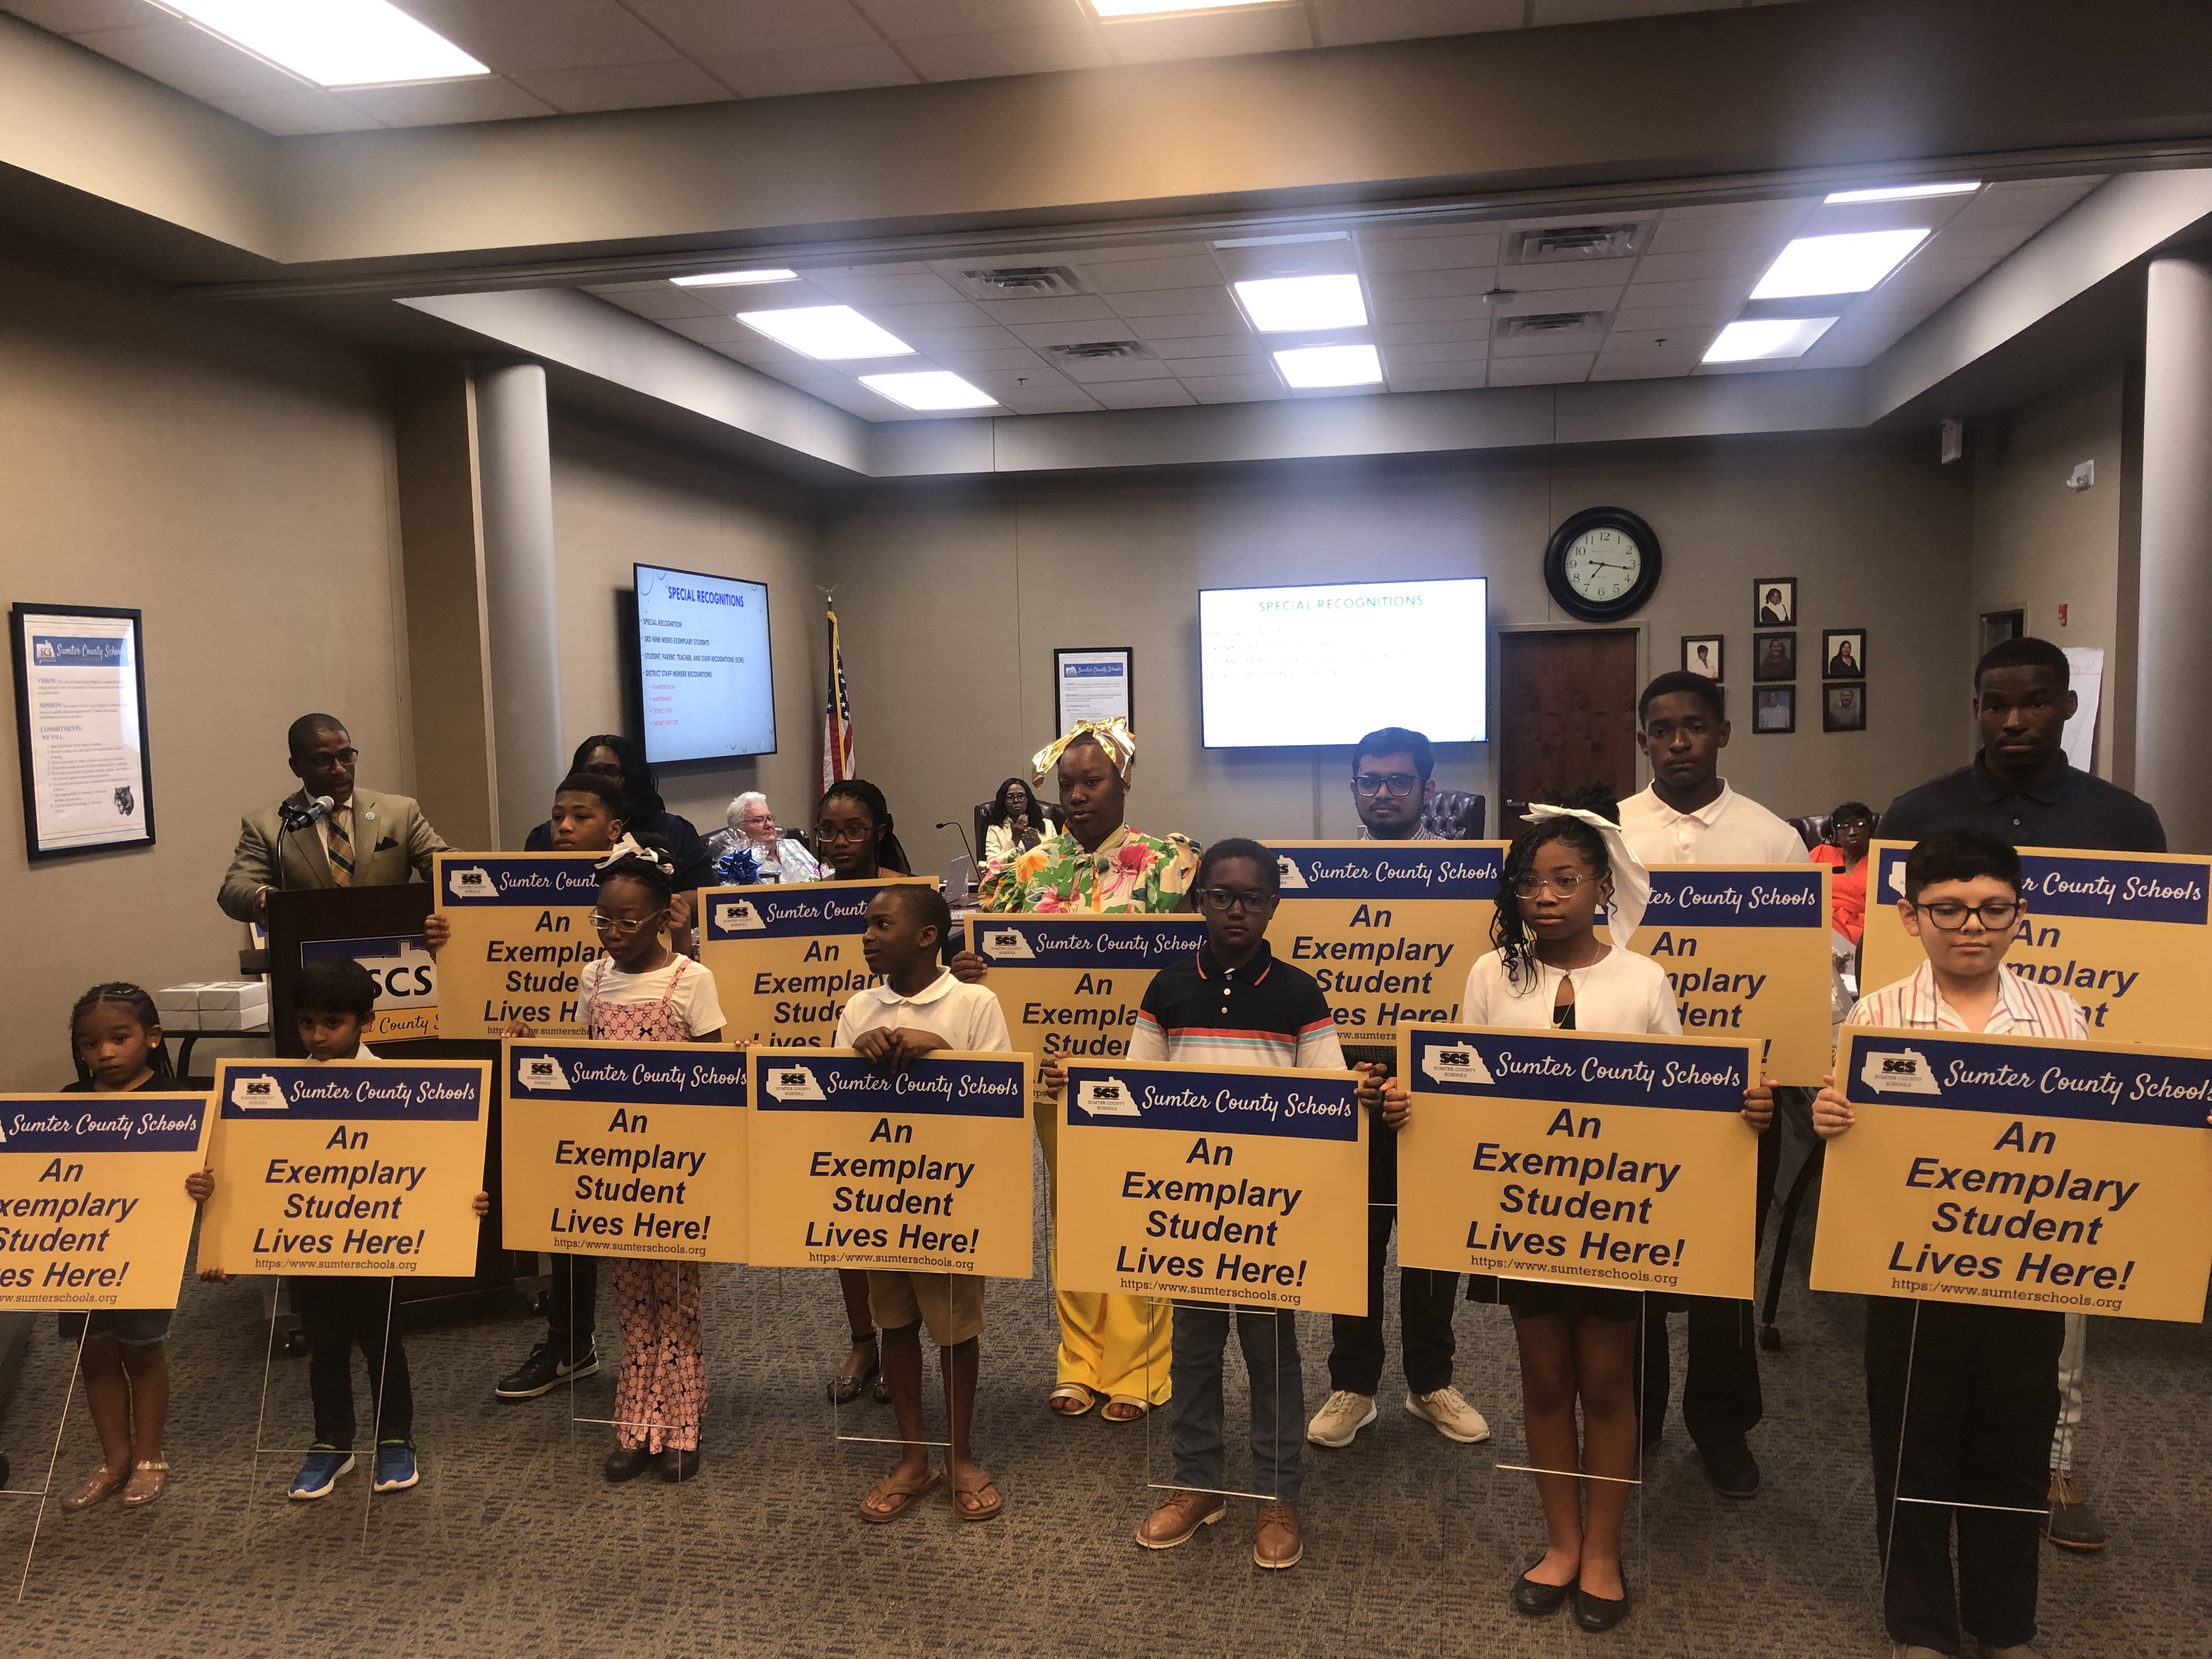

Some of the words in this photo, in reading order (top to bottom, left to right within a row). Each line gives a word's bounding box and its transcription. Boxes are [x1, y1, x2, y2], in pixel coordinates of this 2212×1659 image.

[1586, 536, 1594, 545] 11
[1600, 532, 1610, 541] 12
[1617, 535, 1621, 544] 1
[1575, 547, 1585, 556] 10
[1626, 546, 1632, 554] 2
[1570, 560, 1577, 568] 9
[1629, 560, 1636, 569] 3
[1573, 573, 1580, 582] 8
[1584, 584, 1590, 592] 7
[1613, 584, 1620, 592] 5
[668, 586, 695, 602] SPECIAL
[697, 590, 744, 608] RECOGNITIONS
[1259, 601, 1311, 612] SPECIAL
[1317, 595, 1423, 610] RECOGNITIONS
[1598, 588, 1605, 596] 6
[57, 644, 80, 657] Sumter
[82, 645, 103, 660] County
[1093, 667, 1107, 675] County
[461, 875, 482, 884] SCS
[500, 871, 551, 891] Sumter
[556, 874, 600, 890] Count
[1309, 861, 1372, 883] Sumter
[1376, 861, 1433, 888] County
[1438, 861, 1498, 882] Schools
[1679, 886, 1743, 915] County
[1748, 886, 1815, 909] Schools
[2043, 872, 2117, 904] County
[2123, 877, 2202, 901] Schools
[535, 910, 570, 933] An
[727, 909, 748, 917] SCS
[766, 902, 821, 923] Sumter
[824, 900, 868, 920] Count
[1349, 904, 1392, 928] An
[995, 936, 1017, 945] SCS
[1036, 933, 1093, 953] Sumter
[1097, 934, 1149, 958] County
[1651, 932, 1697, 957] An
[2011, 919, 2061, 948] An
[487, 940, 603, 965] Exemplar
[804, 940, 839, 962] An
[1292, 936, 1454, 967] Exemplary
[506, 970, 579, 992] Stude
[1074, 973, 1113, 995] An
[1316, 969, 1432, 994] Student
[484, 1000, 550, 1022] Lives
[774, 1001, 846, 1024] Stude
[1023, 1002, 1141, 1031] Exempla
[1376, 1002, 1459, 1026] Here!
[380, 1017, 428, 1033] County
[531, 1065, 553, 1074] SCS
[1440, 1053, 1470, 1064] SCS
[1882, 1060, 1916, 1073] SCS
[571, 1062, 629, 1084] Sumter
[633, 1064, 685, 1092] County
[691, 1065, 747, 1087] Schools
[781, 1075, 805, 1084] SCS
[1496, 1051, 1576, 1078] Sumter
[1581, 1057, 1655, 1092] County
[1662, 1061, 1740, 1088] Schools
[1944, 1059, 2035, 1088] Sumter
[2041, 1066, 2123, 1105] County
[247, 1084, 270, 1093] SCS
[290, 1080, 352, 1102] Sumter
[356, 1081, 412, 1108] County
[416, 1082, 475, 1103] Schools
[827, 1071, 891, 1093] Sumter
[896, 1073, 952, 1102] County
[958, 1075, 1018, 1098] Schools
[1093, 1088, 1119, 1098] SCS
[1142, 1086, 1211, 1109] Sumter
[1216, 1089, 1279, 1121] County
[1284, 1093, 1352, 1118] Schools
[9, 1114, 73, 1136] Sumter
[76, 1113, 133, 1140] County
[137, 1113, 196, 1135] Schools
[608, 1108, 648, 1133] An
[870, 1118, 913, 1143] An
[1547, 1108, 1601, 1139] An
[326, 1125, 368, 1150] An
[1994, 1121, 2056, 1154] An
[555, 1140, 706, 1176] Exemplary
[1186, 1138, 1233, 1166] An
[38, 1158, 83, 1182] An
[265, 1159, 427, 1191] Exemplary
[809, 1152, 975, 1188] Exemplary
[1472, 1142, 1681, 1193] Exemplary
[575, 1175, 686, 1204] Student
[1122, 1171, 1302, 1216] Exemplary
[1906, 1158, 2140, 1212] Exemplary
[0, 1192, 139, 1223] xemplary
[284, 1194, 403, 1219] Student
[833, 1187, 953, 1216] Student
[1500, 1184, 1653, 1224] Student
[551, 1208, 624, 1235] Lives
[634, 1212, 711, 1240] Here!
[1146, 1210, 1278, 1246] Student
[1932, 1202, 2104, 1245] Student
[253, 1228, 334, 1254] Lives
[342, 1229, 425, 1255] Here!
[554, 1238, 706, 1257] https:/www.sumterschools.org
[805, 1222, 888, 1248] Lives
[898, 1223, 979, 1253] Here!
[1466, 1221, 1567, 1256] Lives
[1580, 1232, 1685, 1267] Here!
[42, 1261, 130, 1287] Here!
[255, 1259, 417, 1271] https:/www.sumterschools.org
[809, 1252, 974, 1271] https:/www.sumterschools.org
[1116, 1246, 1204, 1278] Lives
[1216, 1254, 1307, 1287] Here!
[1471, 1255, 1678, 1286] https:/www.sumterschools.org
[1888, 1242, 2002, 1279] Lives
[2016, 1252, 2135, 1291] Here!
[1120, 1278, 1301, 1305] https:/www.sumterschools.org
[1892, 1278, 2123, 1311] https:/www.sumterschools.org
